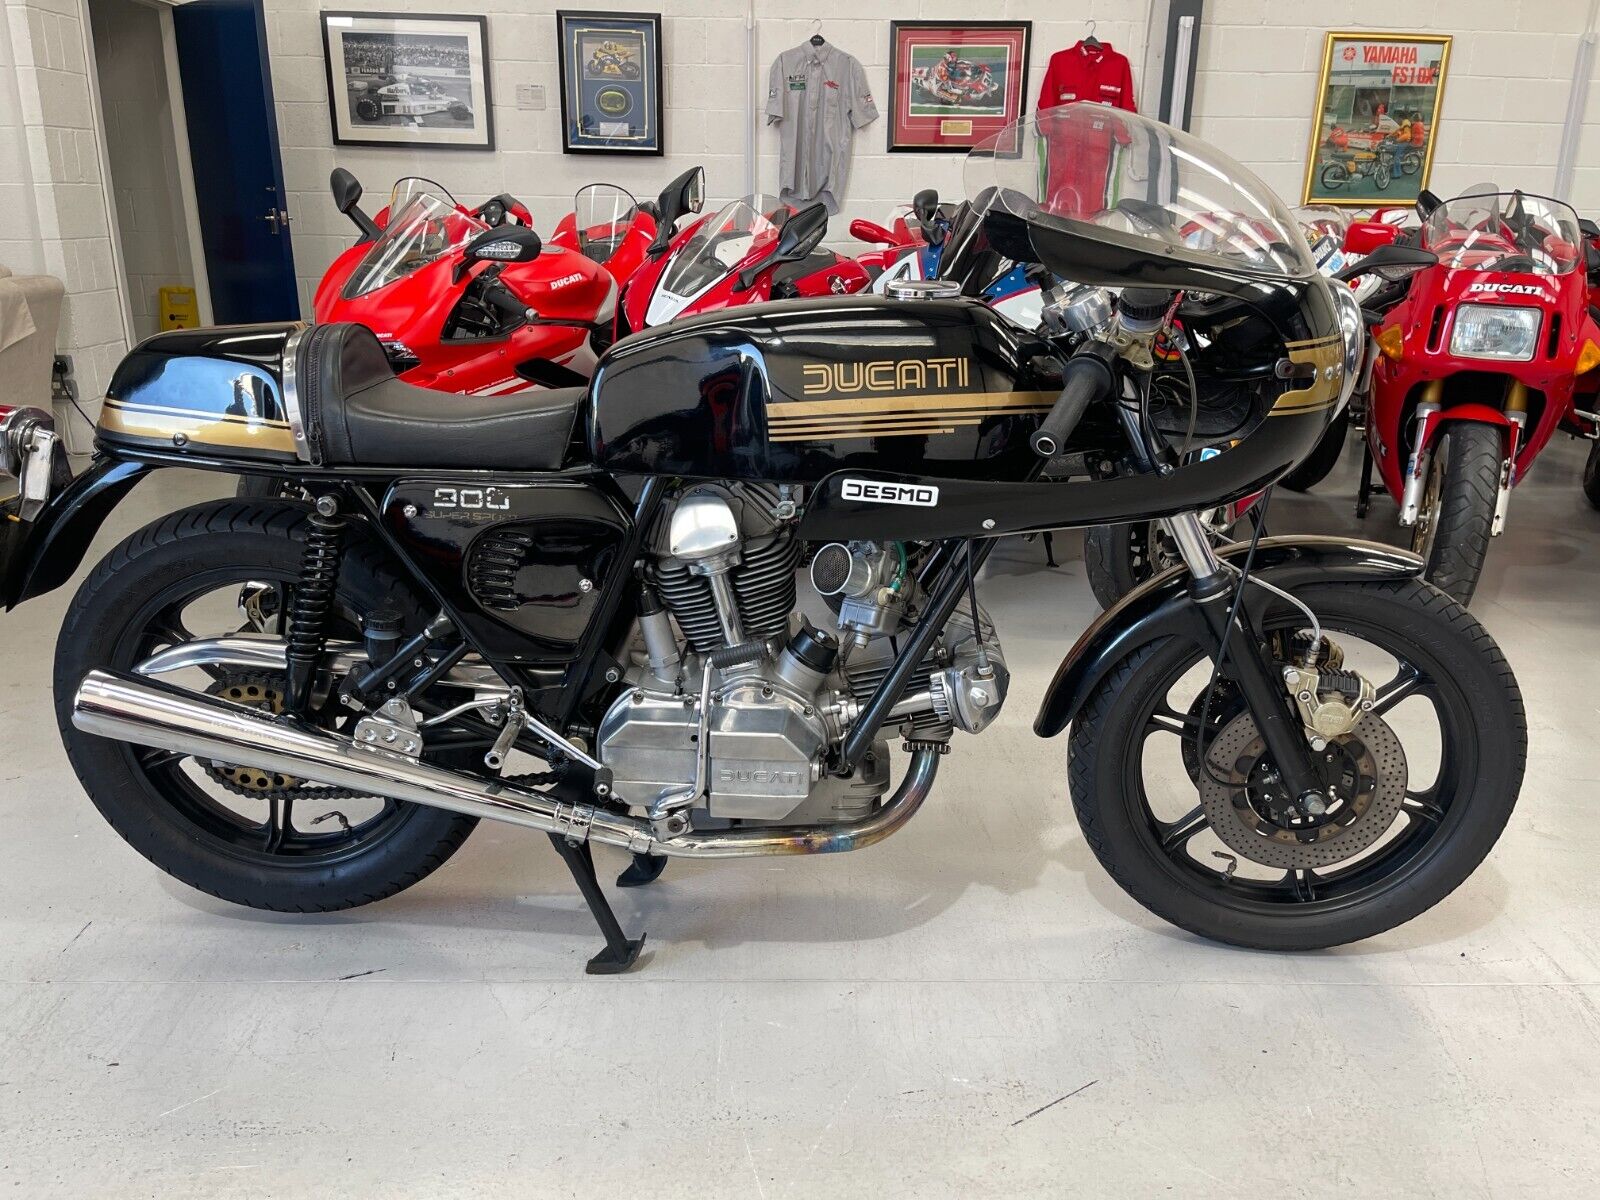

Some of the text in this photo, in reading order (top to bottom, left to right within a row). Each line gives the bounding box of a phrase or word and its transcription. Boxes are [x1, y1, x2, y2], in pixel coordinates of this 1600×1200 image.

[1363, 46, 1417, 64] YAMAHA
[550, 272, 582, 290] DUCATI
[1469, 283, 1543, 296] DUCATI
[803, 357, 968, 394] DUCATI
[846, 483, 933, 503] DESMO
[720, 769, 804, 785] DUCATI
